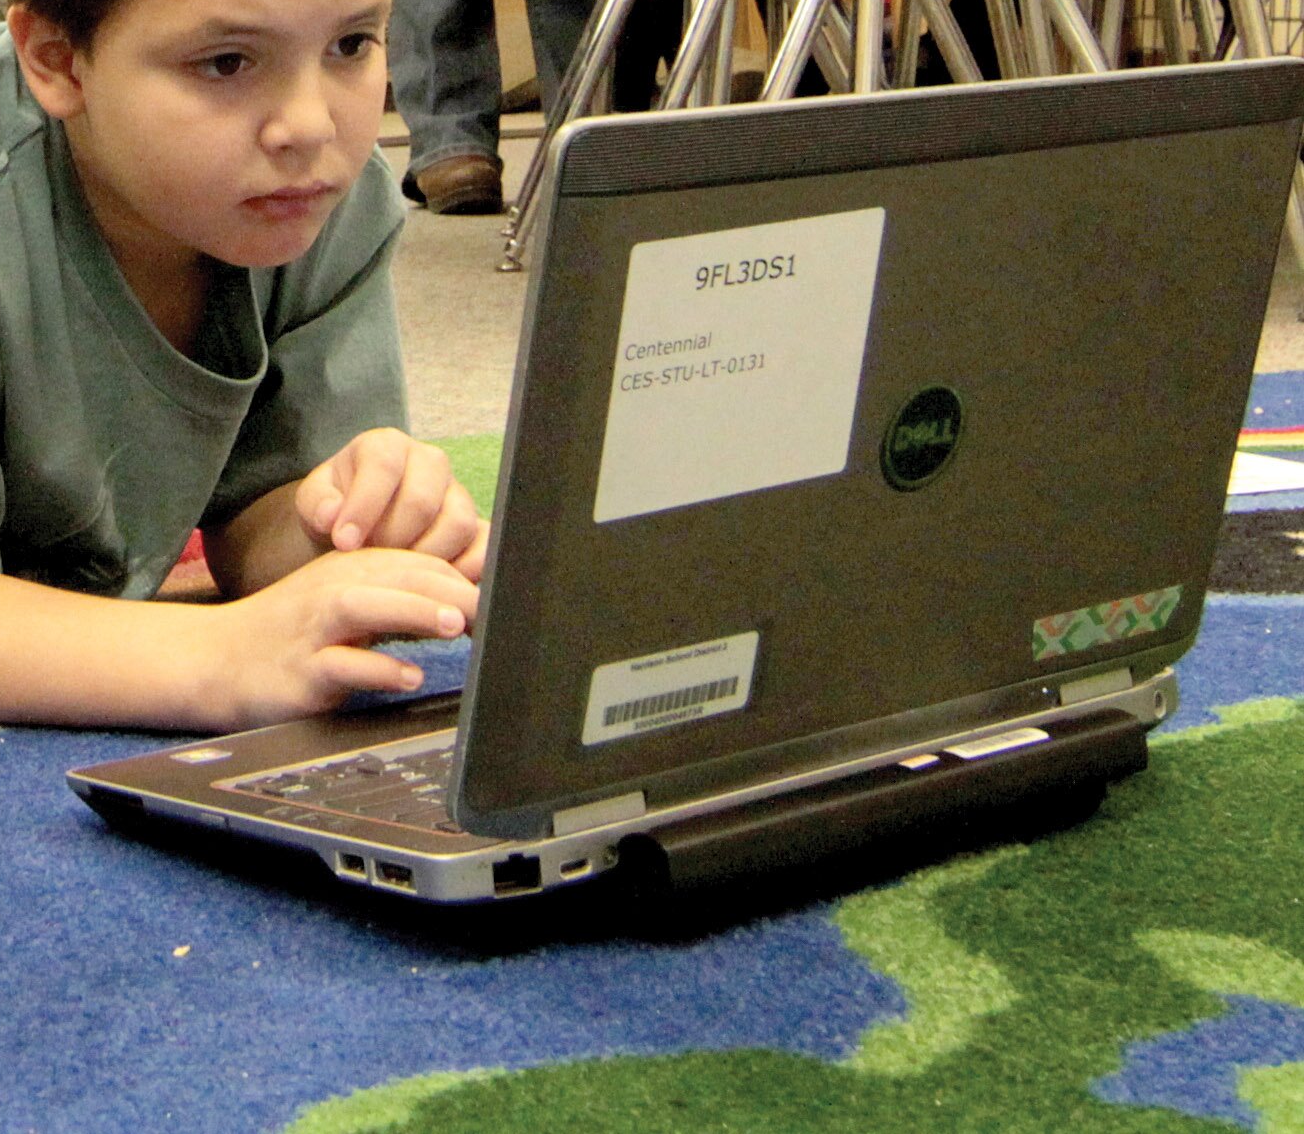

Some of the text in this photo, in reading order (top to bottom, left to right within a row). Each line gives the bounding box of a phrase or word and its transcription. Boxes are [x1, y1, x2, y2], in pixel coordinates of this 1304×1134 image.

[695, 254, 797, 291] 9FL3DS1
[624, 332, 713, 361] Centennial
[619, 353, 766, 392] CES-STU-LT-0131
